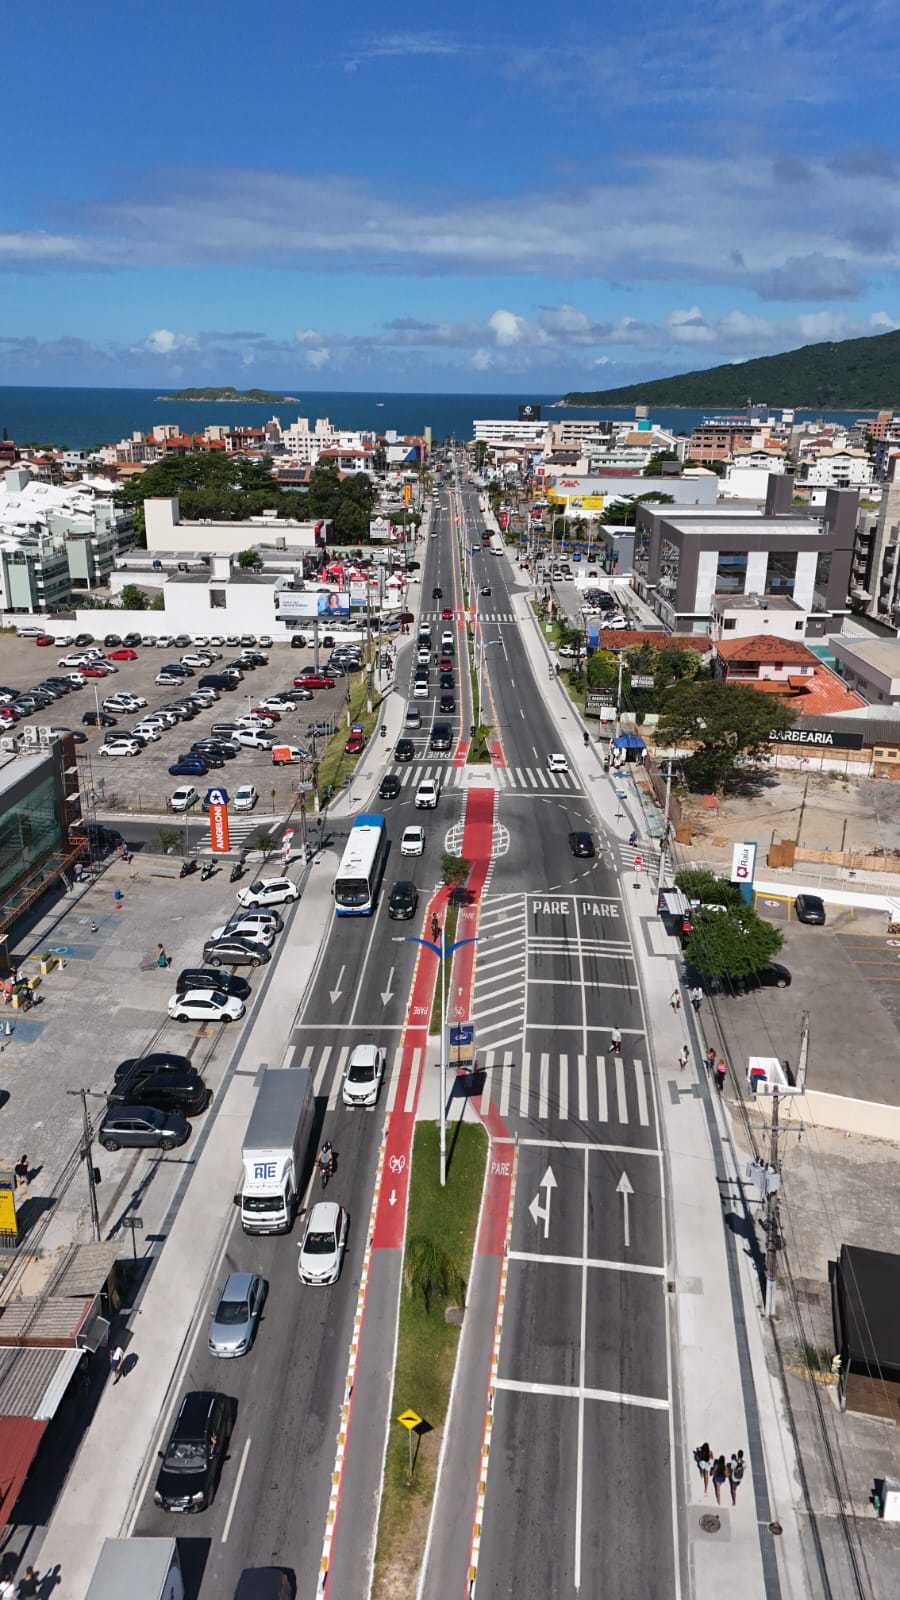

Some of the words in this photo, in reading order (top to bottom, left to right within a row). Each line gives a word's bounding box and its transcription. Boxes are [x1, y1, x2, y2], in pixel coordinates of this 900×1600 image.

[769, 729, 833, 744] BARBEARIA
[216, 806, 224, 849] ANGELONI
[533, 901, 570, 915] PARE
[583, 902, 619, 917] PARE
[413, 1006, 428, 1014] PARE
[253, 1161, 278, 1179] RTE
[490, 1161, 511, 1176] PARE
